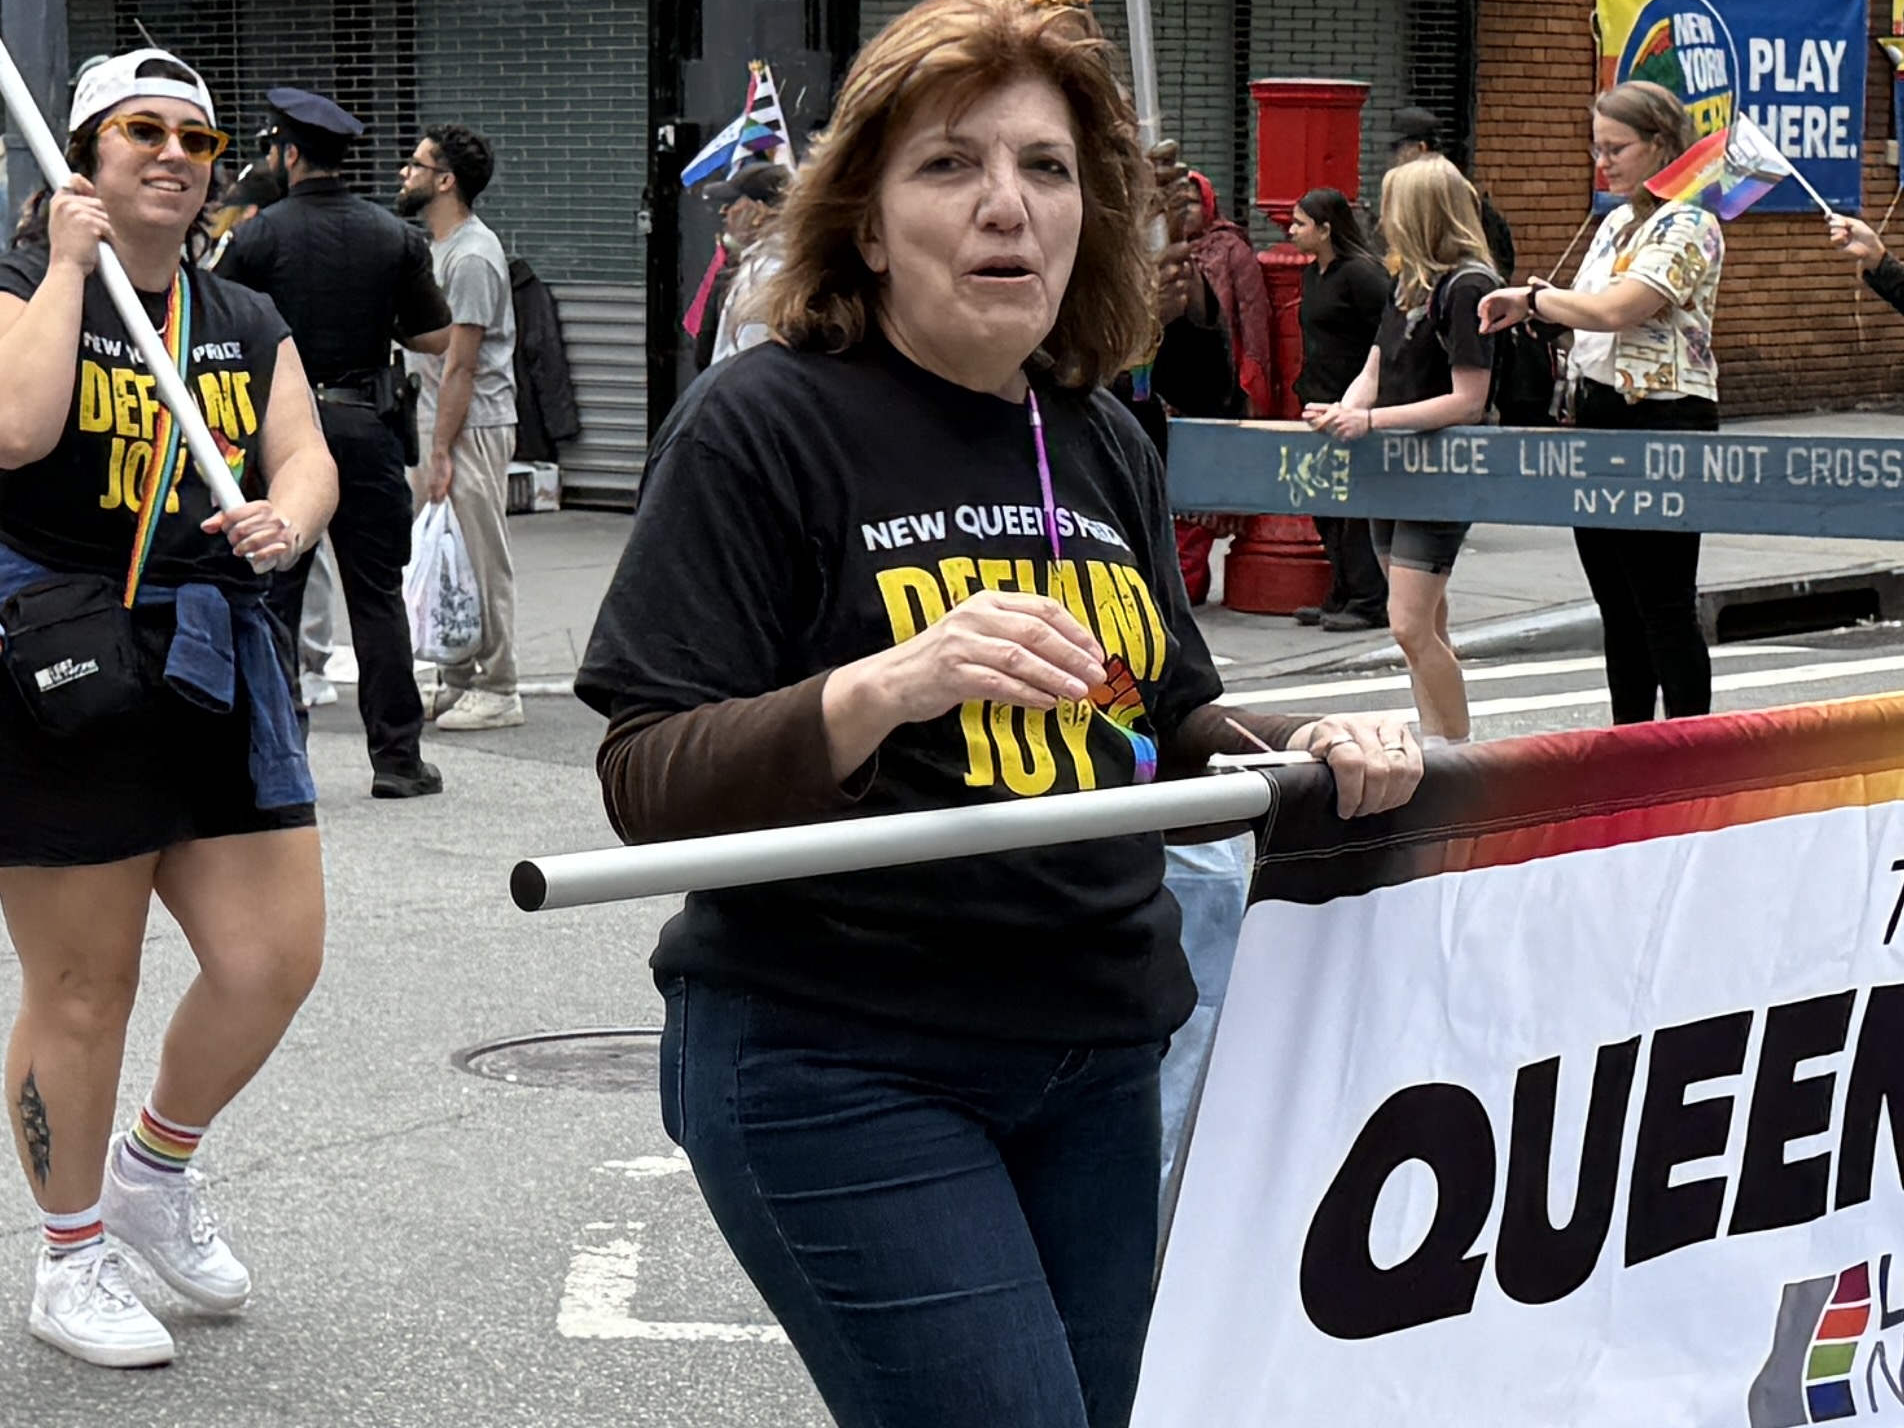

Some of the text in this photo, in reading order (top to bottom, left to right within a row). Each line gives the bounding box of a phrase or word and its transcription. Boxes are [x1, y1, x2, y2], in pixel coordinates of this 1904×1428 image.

[1673, 13, 1715, 47] NEW
[1678, 47, 1728, 95] YORK
[1748, 38, 1846, 93] PLAY
[1748, 104, 1858, 160] HERE.
[79, 360, 258, 441] DEFNT
[1383, 438, 1490, 474] POLICE
[1519, 439, 1587, 478] LINE
[1644, 442, 1686, 481] DO
[1702, 444, 1768, 484] NOT
[1786, 447, 1903, 488] CROSS
[1573, 488, 1686, 517] NYPD
[861, 511, 946, 552] NEW
